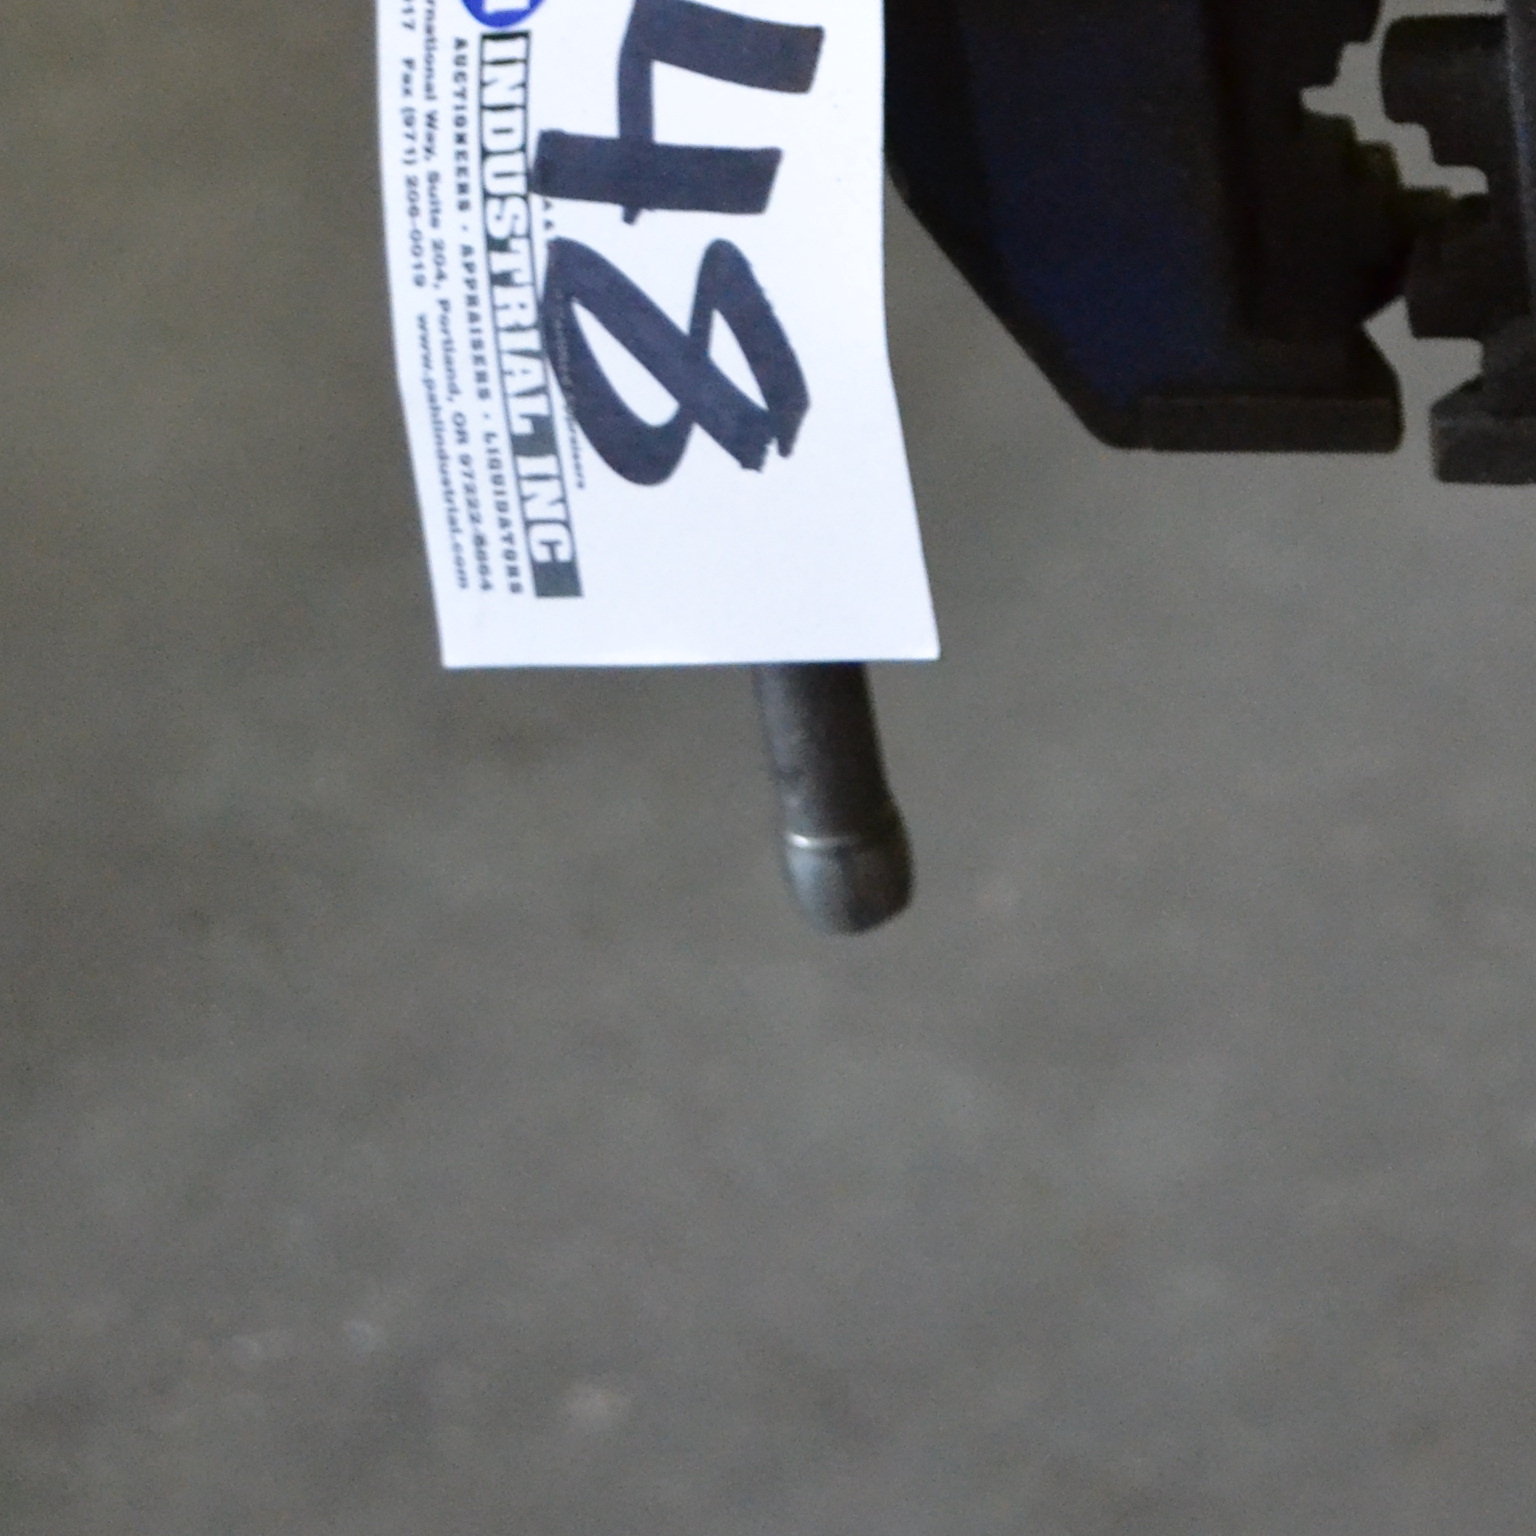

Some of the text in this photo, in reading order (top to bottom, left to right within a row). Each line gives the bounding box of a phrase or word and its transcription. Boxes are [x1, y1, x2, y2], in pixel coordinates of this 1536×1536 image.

[452, 36, 523, 594] AUCTIONEERS APPRAISERS LIQUIDATORS
[479, 35, 548, 436] INDUSTRIAL
[450, 411, 468, 445] OR
[513, 454, 573, 563] INC
